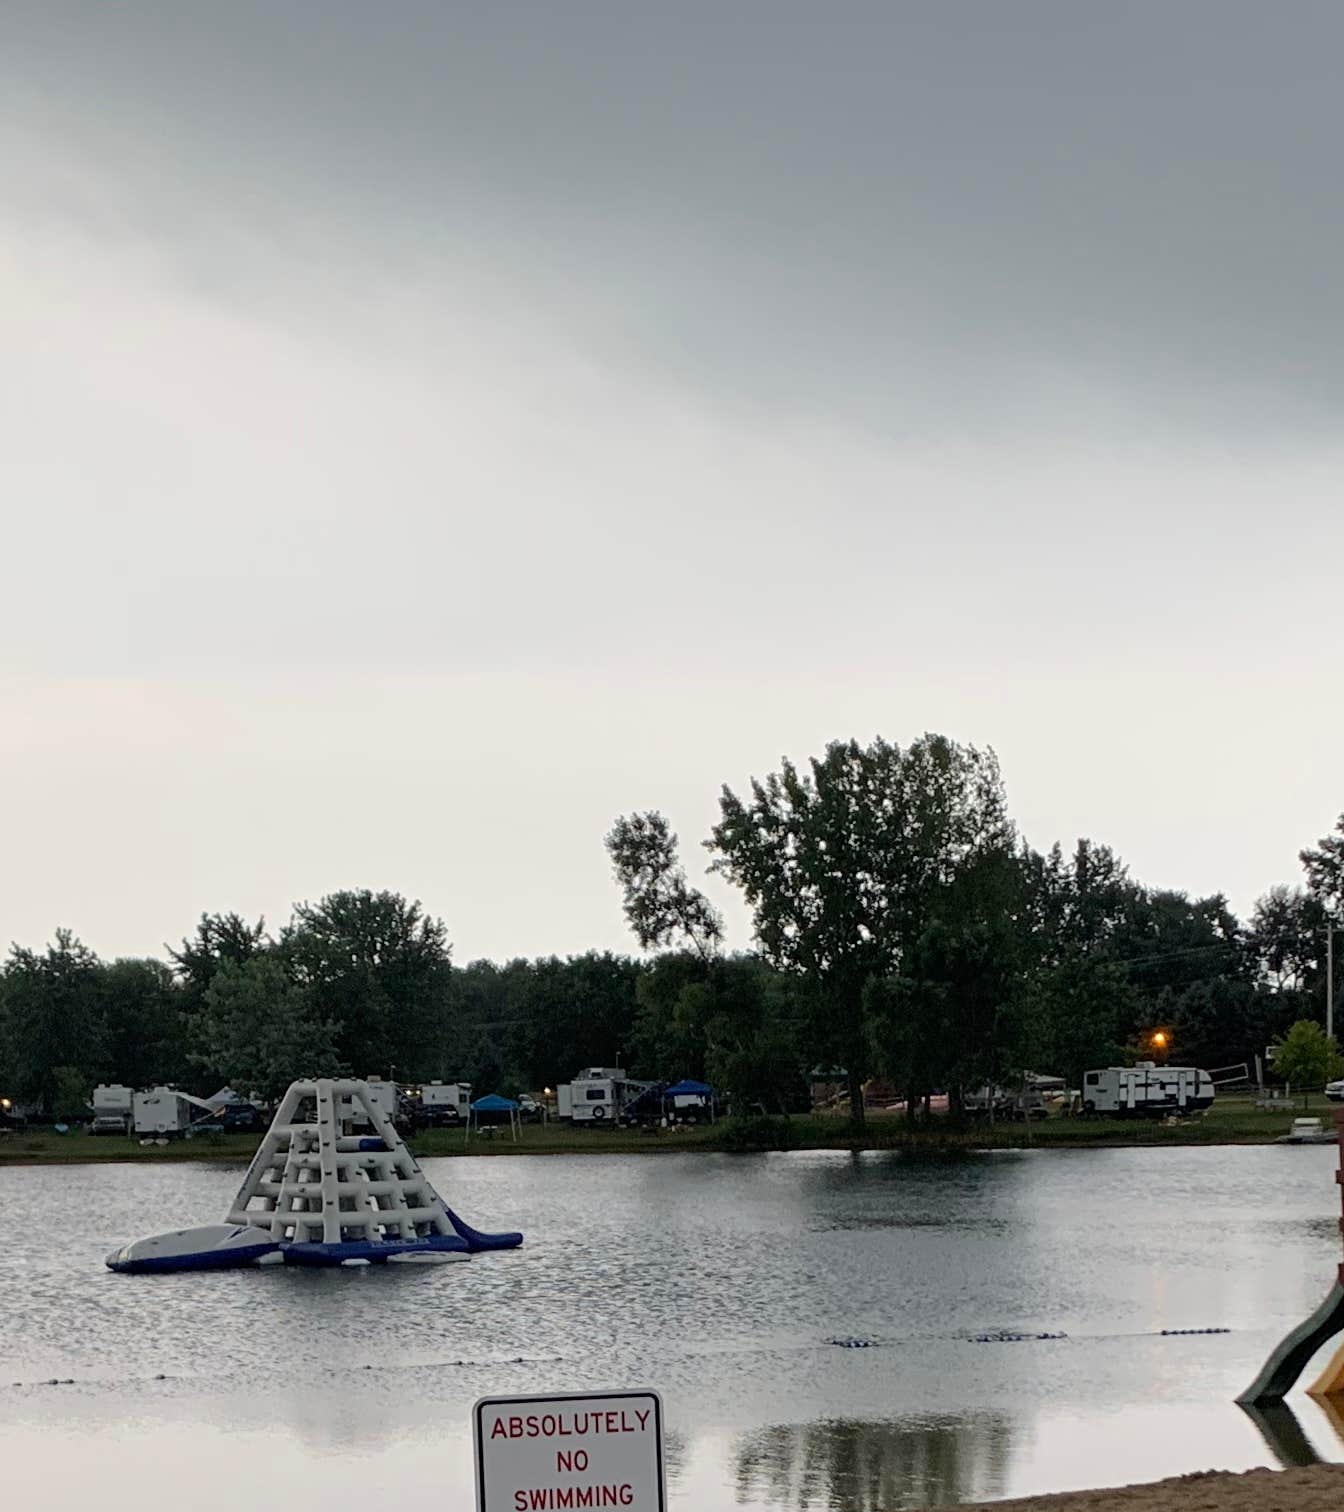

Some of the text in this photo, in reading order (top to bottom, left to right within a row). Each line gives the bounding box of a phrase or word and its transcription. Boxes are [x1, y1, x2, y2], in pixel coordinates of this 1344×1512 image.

[491, 1410, 651, 1439] ABSOLUTELY
[557, 1451, 589, 1472] NO
[514, 1484, 634, 1511] SWIMMING
